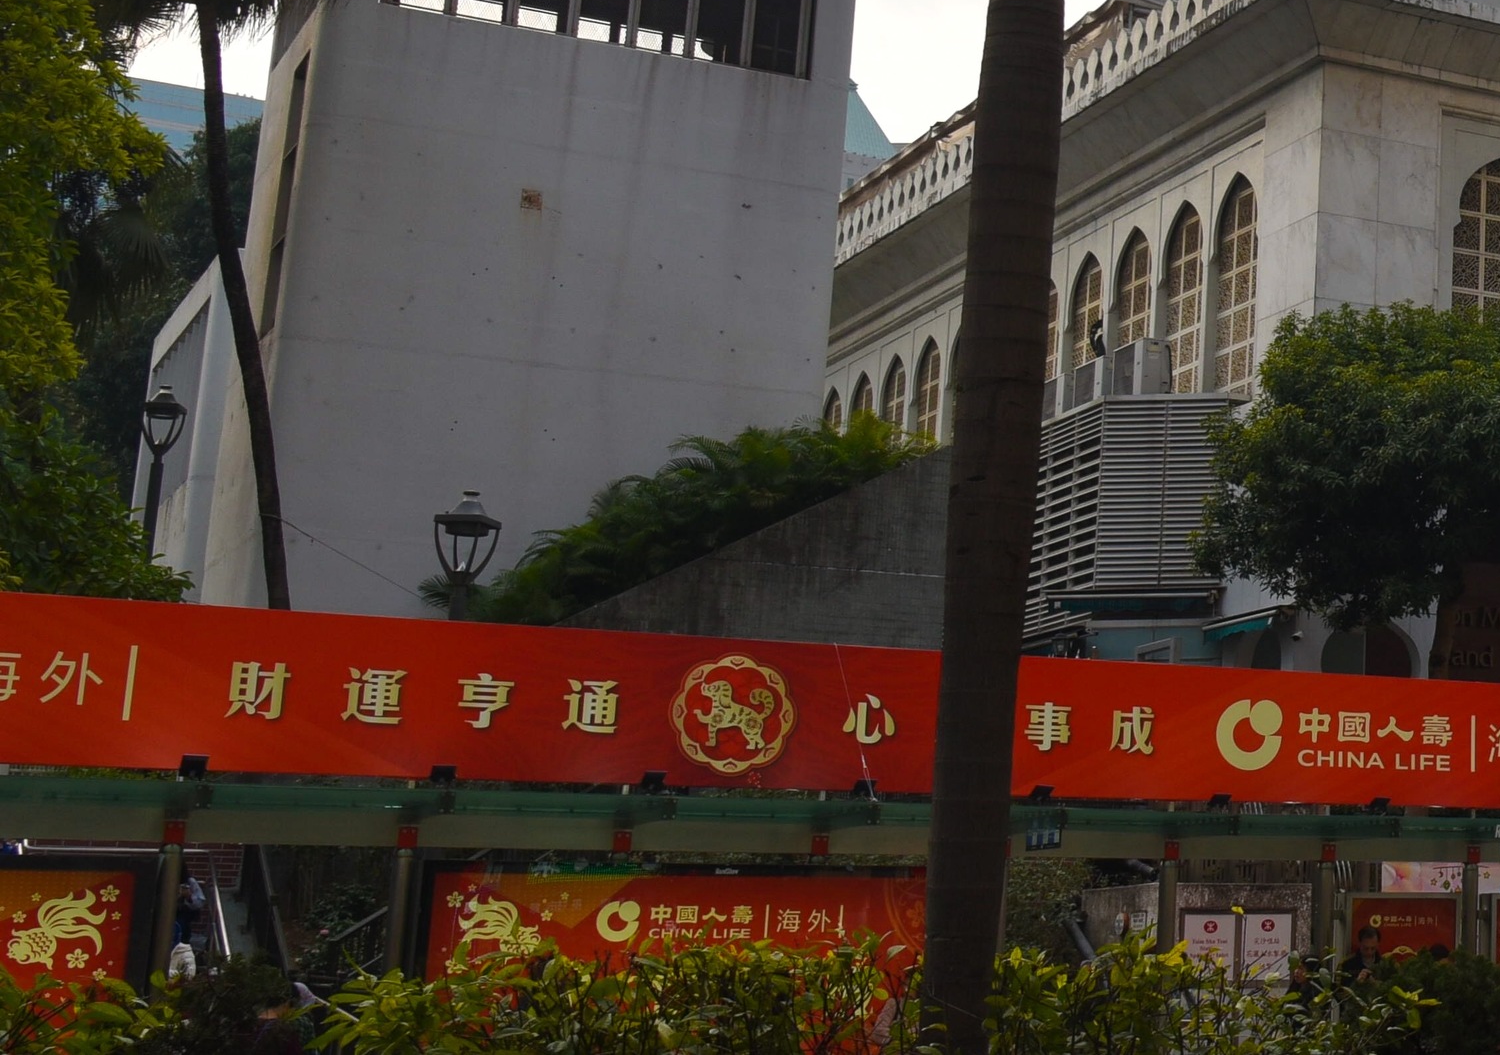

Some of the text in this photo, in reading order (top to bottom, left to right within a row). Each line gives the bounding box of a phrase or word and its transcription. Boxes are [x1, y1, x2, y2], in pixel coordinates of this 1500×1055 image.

[224, 661, 620, 734] 財運亨通
[1298, 708, 1453, 747] 中國人壽
[1298, 749, 1450, 771] CHINA LIFE
[648, 927, 751, 939] CHINA LIFE
[650, 904, 832, 933] 中國人壽 海外
